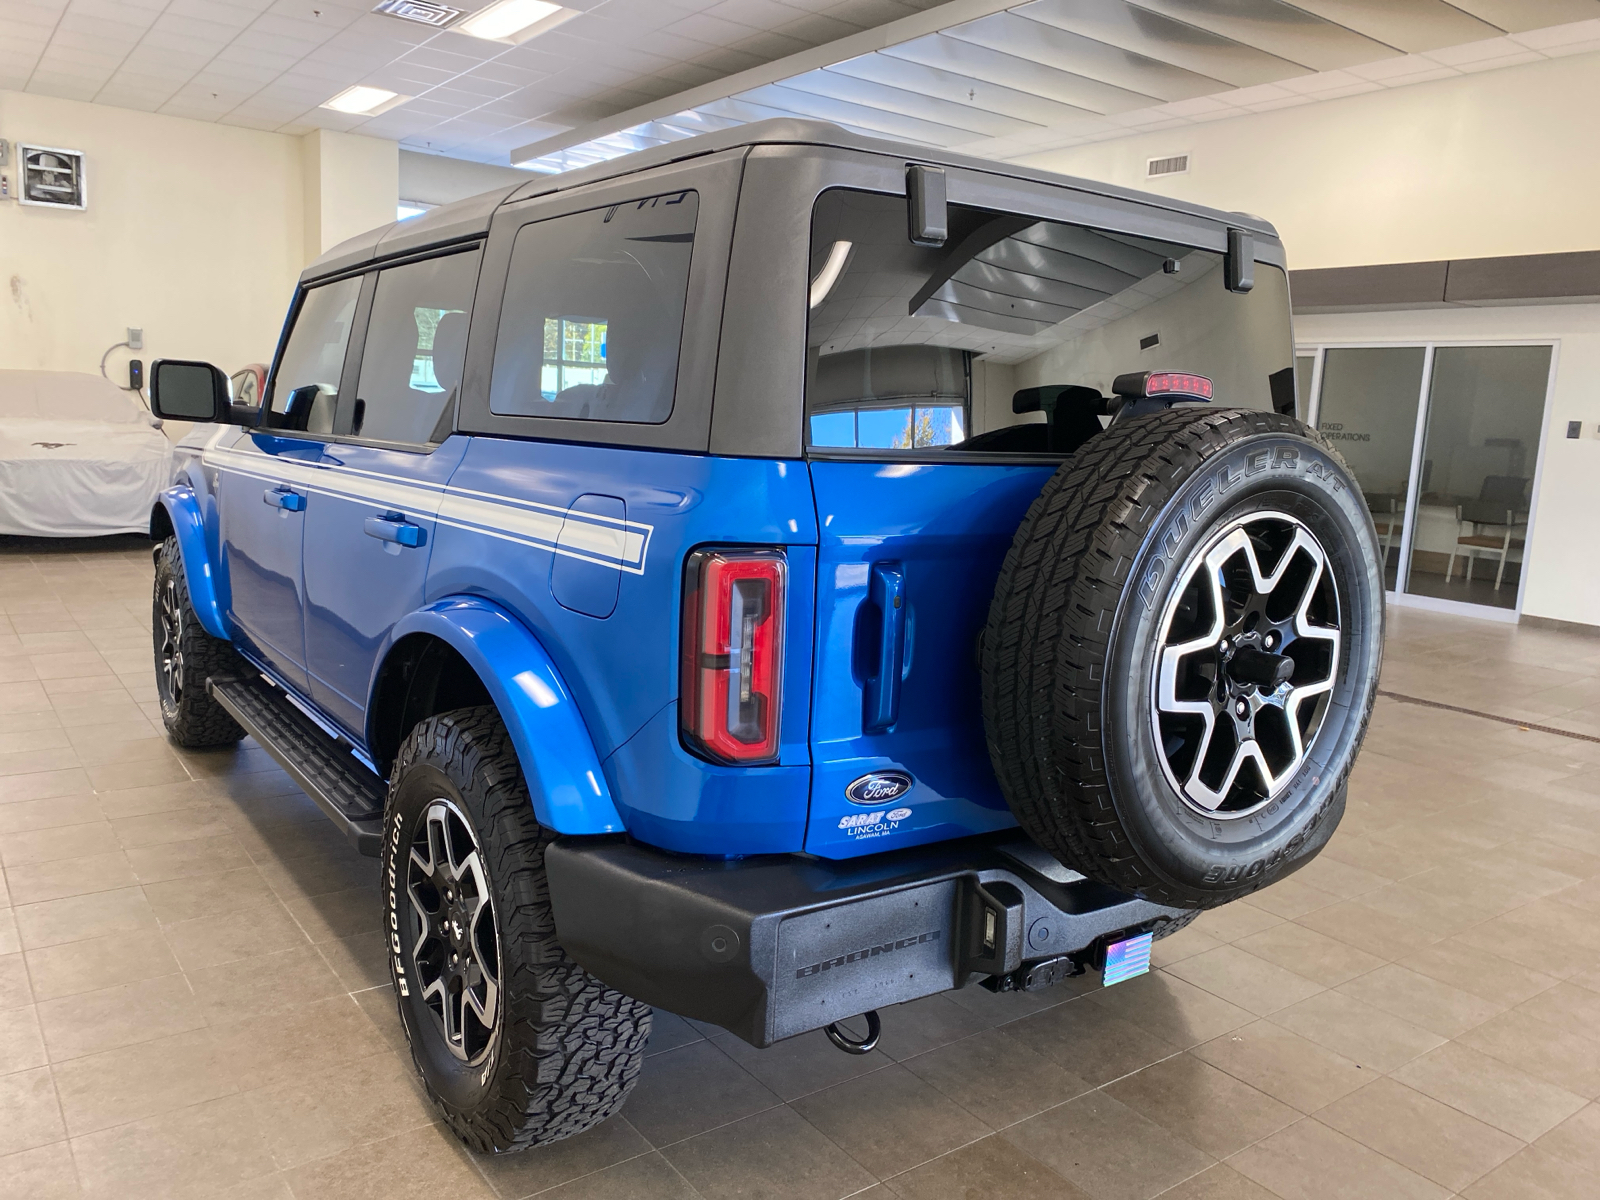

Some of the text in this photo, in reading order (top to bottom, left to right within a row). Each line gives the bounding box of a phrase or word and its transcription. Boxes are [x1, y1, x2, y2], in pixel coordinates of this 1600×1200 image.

[1321, 422, 1343, 431] FIXED
[1320, 431, 1371, 442] OPERATIONS
[1137, 446, 1347, 610] DUELER A/T
[863, 780, 899, 800] Ford
[838, 811, 886, 829] SARAT
[847, 820, 899, 836] LINCOLN
[388, 811, 410, 998] BFGoodrich
[796, 930, 941, 979] BRONCO
